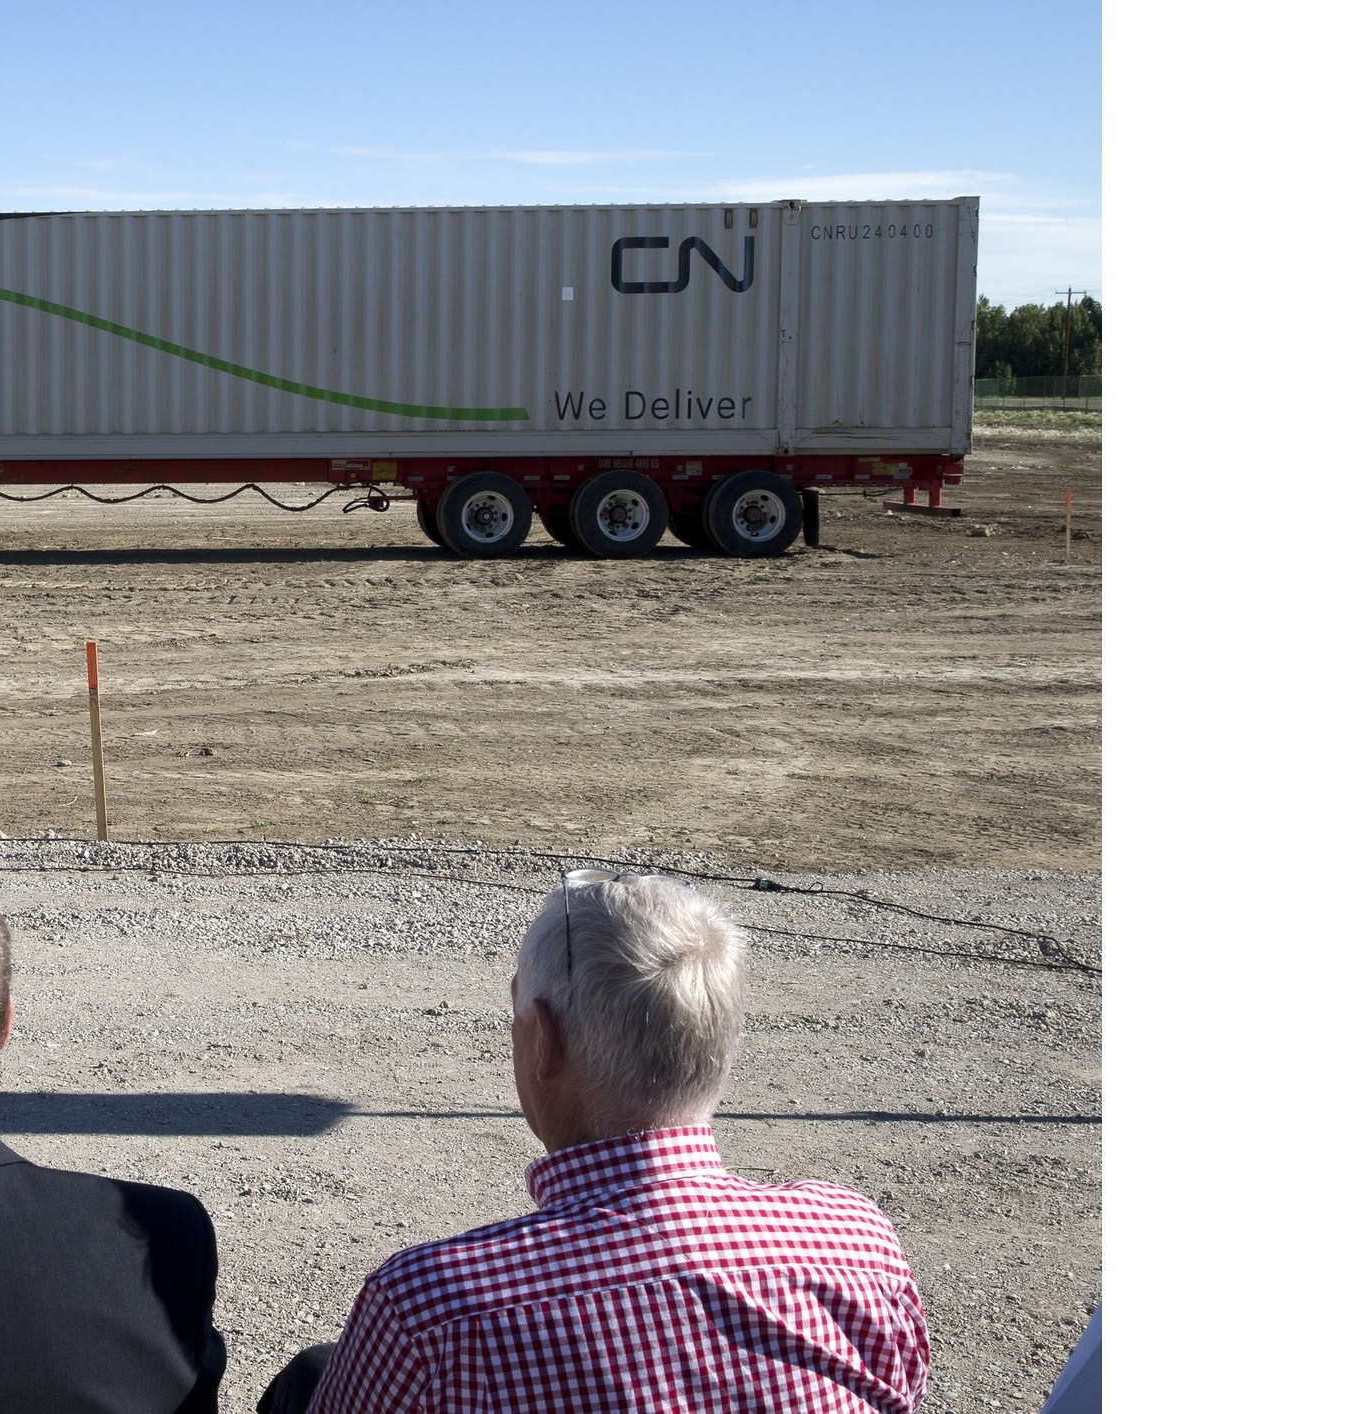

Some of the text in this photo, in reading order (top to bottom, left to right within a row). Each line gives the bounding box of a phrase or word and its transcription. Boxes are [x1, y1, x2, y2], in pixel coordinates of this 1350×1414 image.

[611, 235, 755, 294] CN
[554, 388, 752, 420] We Deliver
